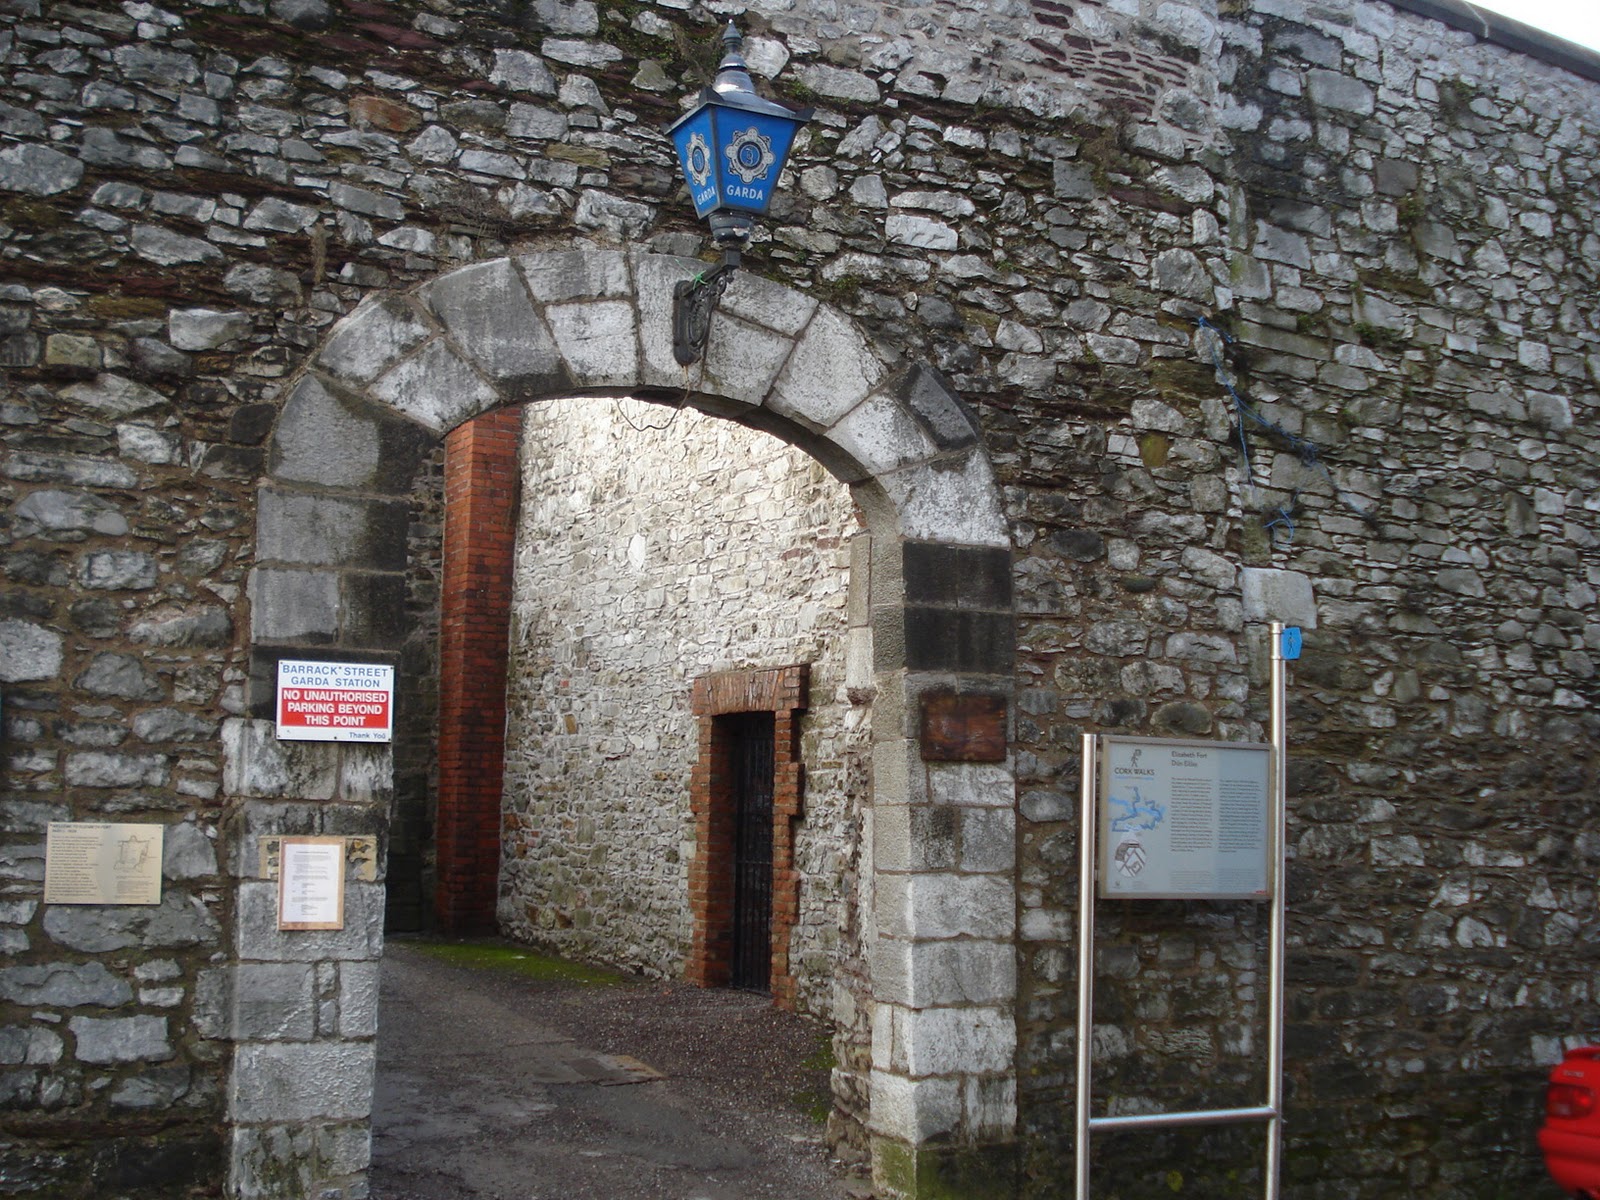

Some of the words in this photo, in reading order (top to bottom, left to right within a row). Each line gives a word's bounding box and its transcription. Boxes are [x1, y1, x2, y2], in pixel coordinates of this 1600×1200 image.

[697, 186, 716, 205] GARDA
[727, 184, 763, 201] GARDA
[282, 665, 338, 675] BARRACK
[344, 667, 388, 677] STREET
[291, 676, 329, 686] GARDA
[335, 678, 380, 688] STATION
[283, 690, 300, 700] NO
[304, 691, 387, 703] UNAUTHORISED
[287, 702, 335, 713] PARKING
[338, 703, 383, 715] BEYOND
[304, 715, 329, 725] THIS
[333, 716, 366, 726] POINT
[1114, 767, 1133, 775] CORK
[1134, 768, 1155, 776] WALKS
